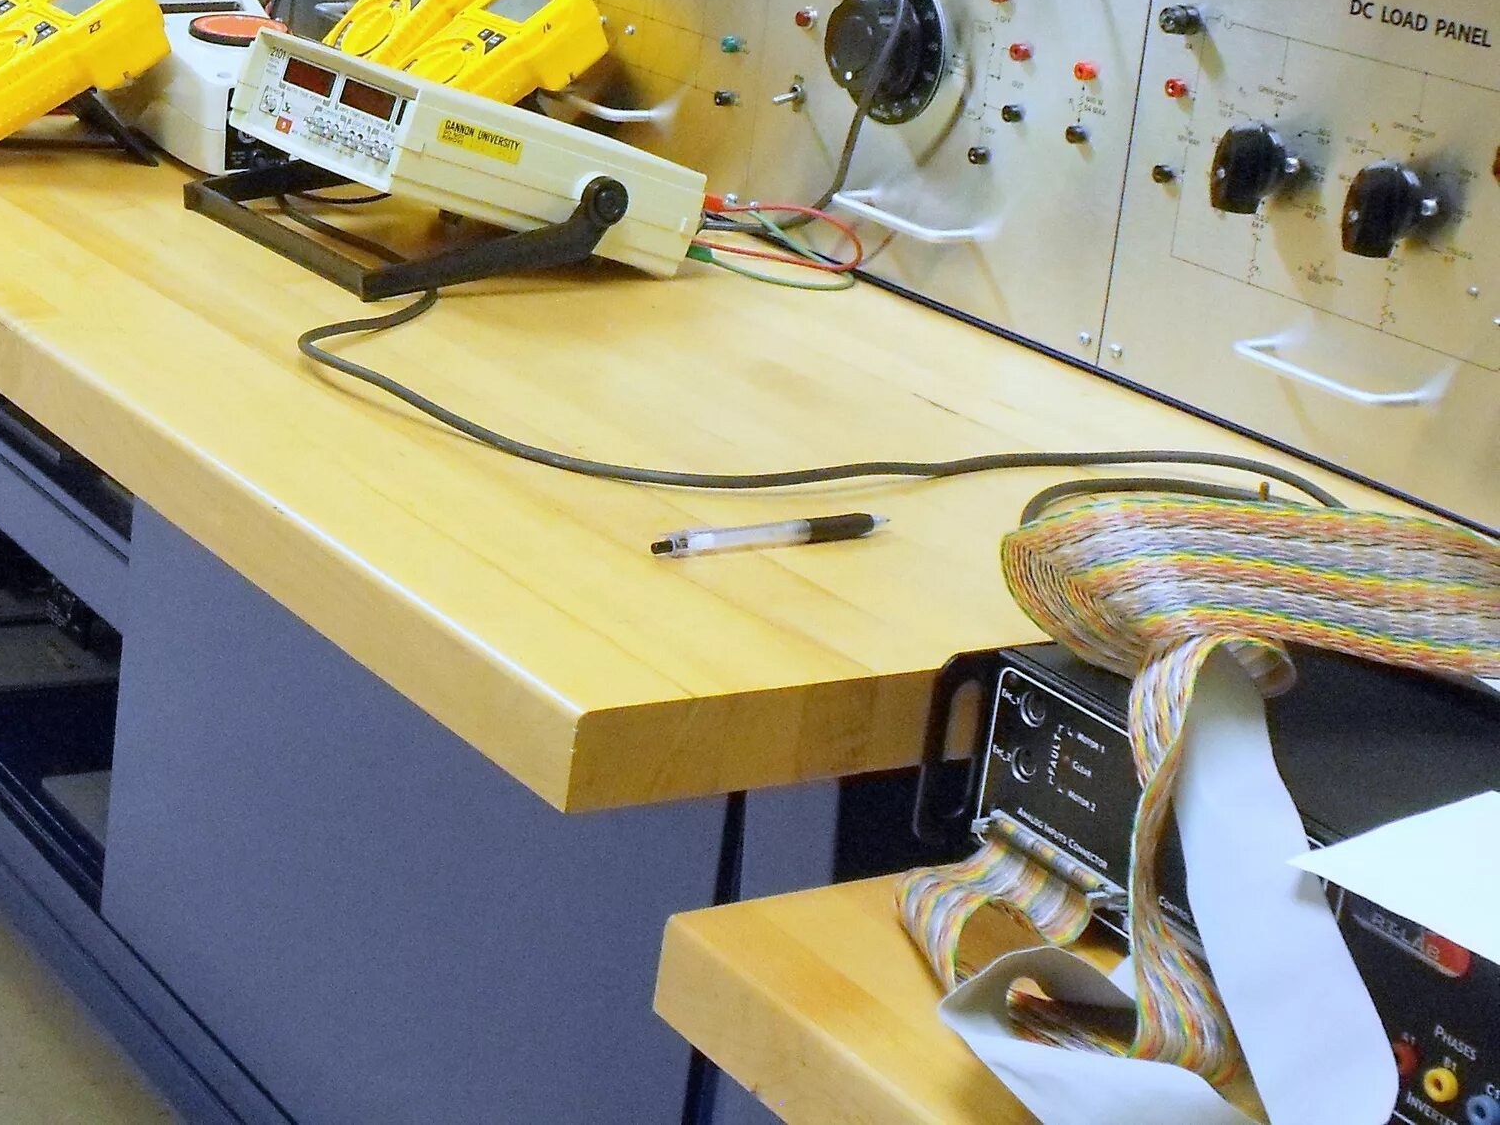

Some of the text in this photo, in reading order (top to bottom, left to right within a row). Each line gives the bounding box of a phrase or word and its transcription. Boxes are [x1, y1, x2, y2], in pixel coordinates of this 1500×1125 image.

[1381, 6, 1429, 32] LOAD
[1435, 18, 1492, 48] PANEL
[445, 119, 521, 151] GANNON UNIVERSITY
[1048, 733, 1061, 776] FAULT
[1068, 838, 1108, 870] CONNECTOR
[1434, 1024, 1477, 1061] PHASES
